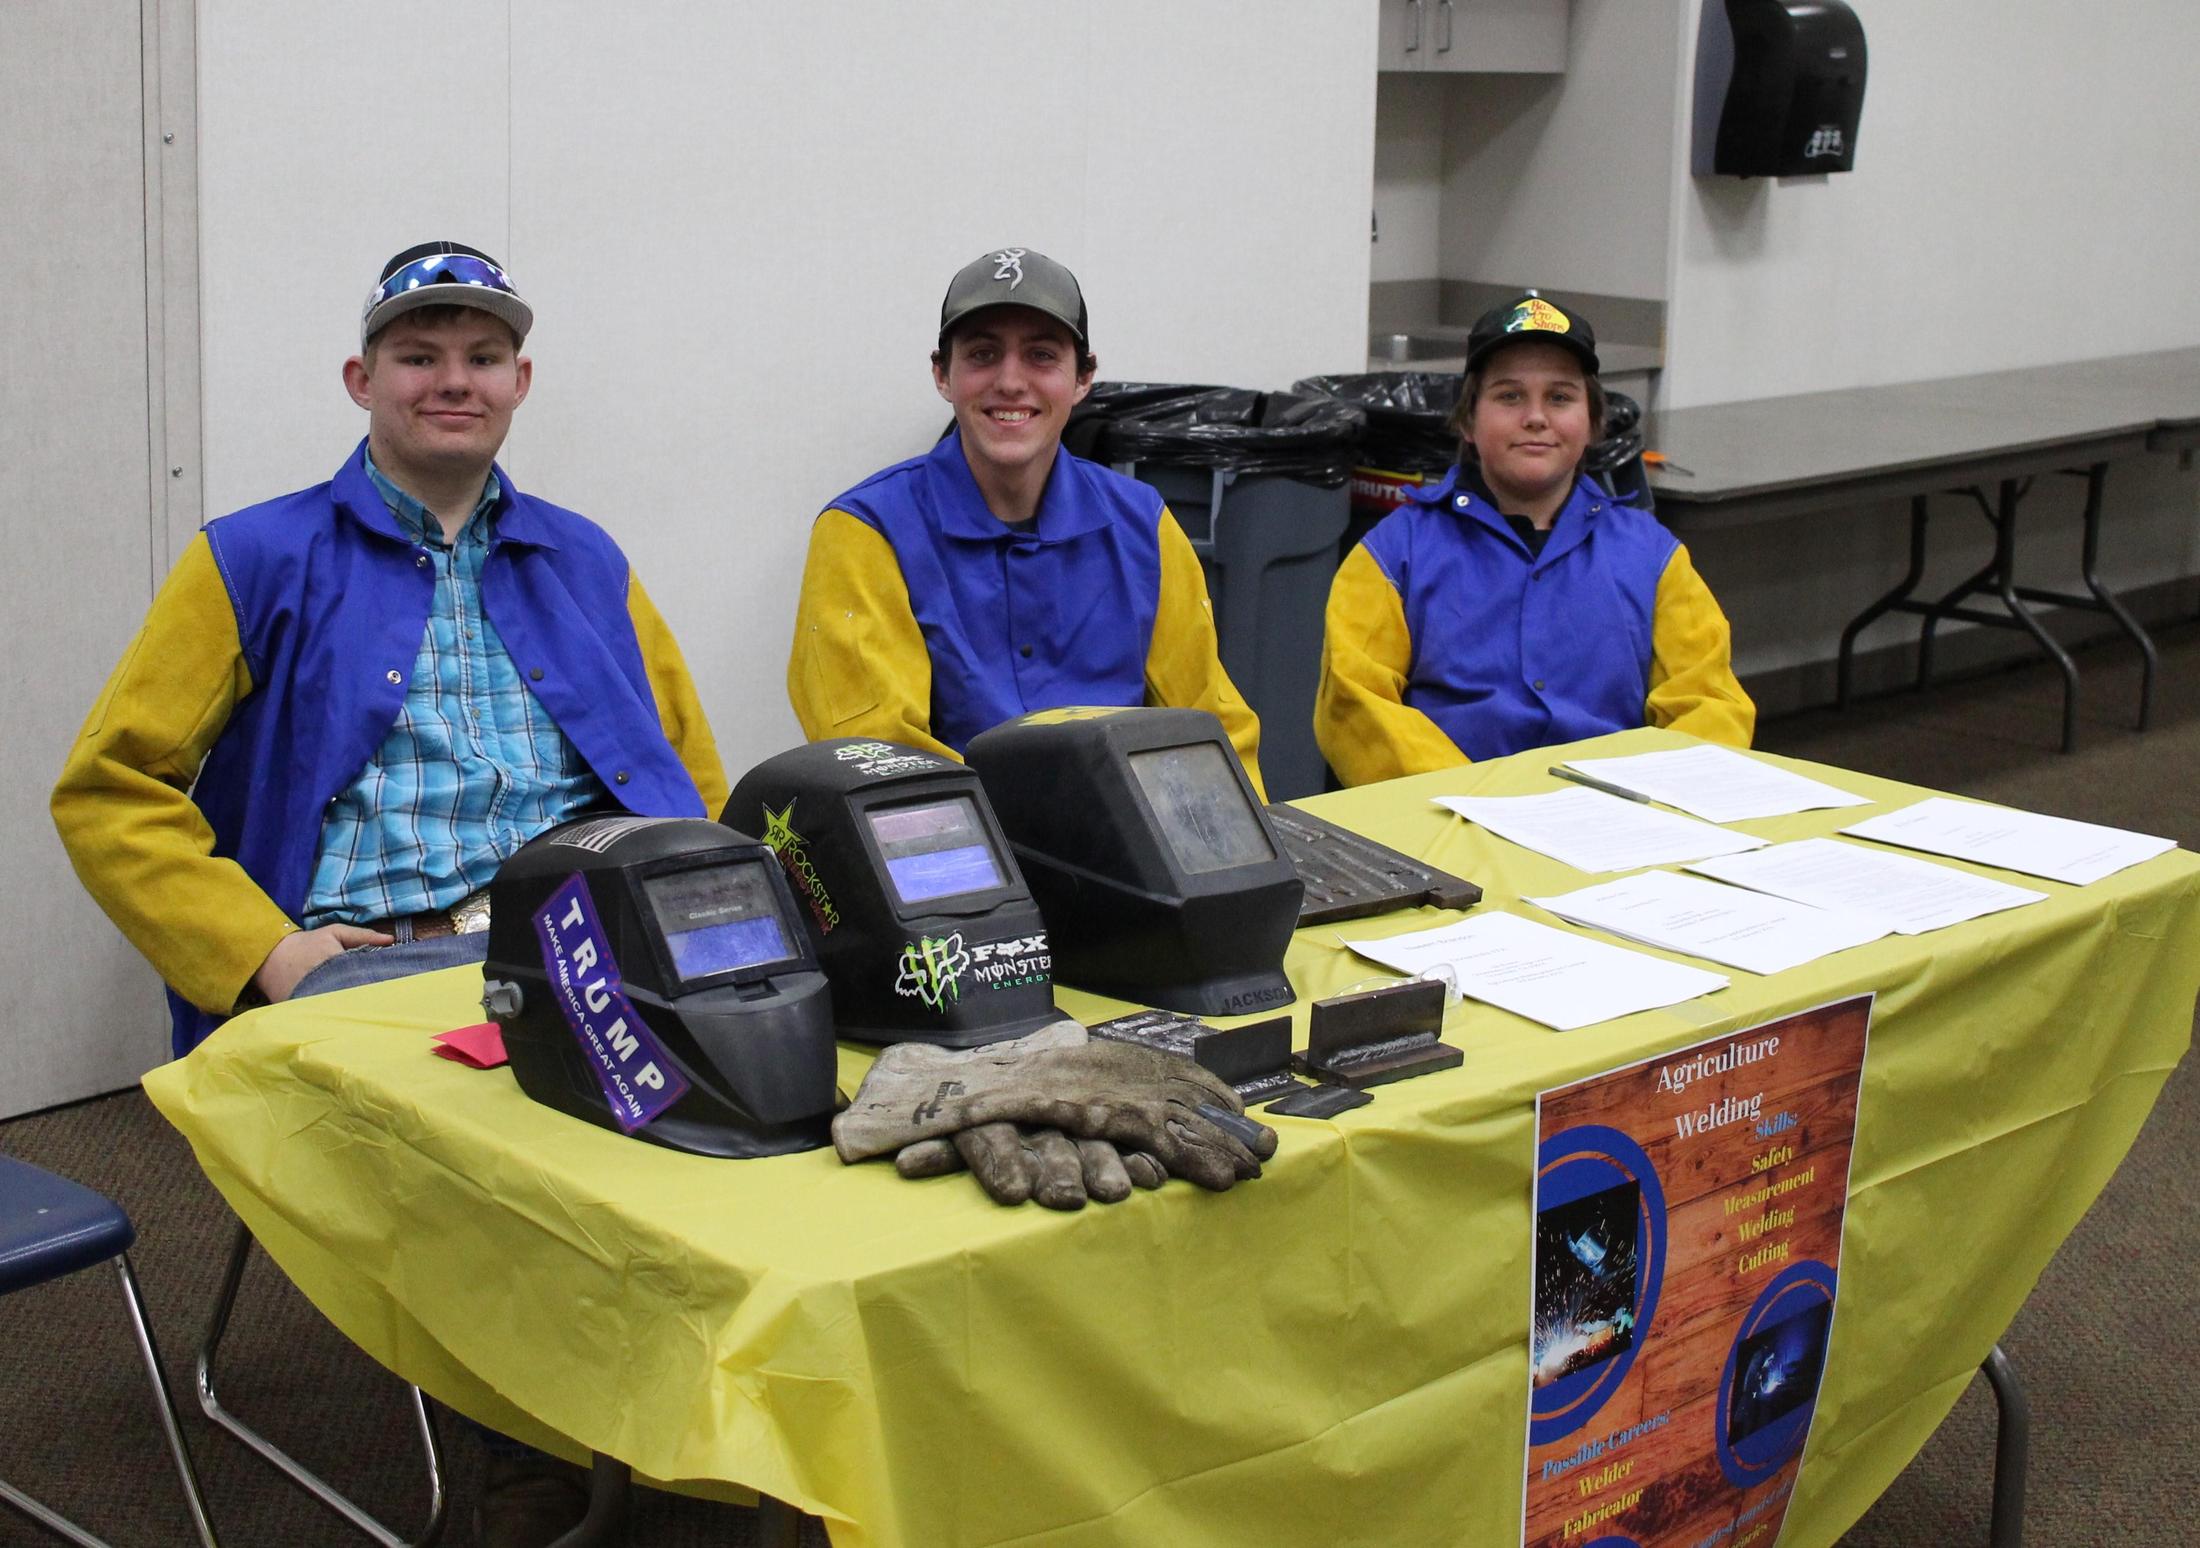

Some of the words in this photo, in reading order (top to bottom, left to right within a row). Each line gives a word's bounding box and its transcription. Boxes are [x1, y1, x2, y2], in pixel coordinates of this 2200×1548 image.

[562, 897, 665, 1090] TRUMP
[992, 974, 1050, 990] ENERGY
[544, 914, 563, 957] MAKE
[558, 959, 585, 1023] AMERICA
[585, 1024, 615, 1070] GREAT
[612, 1074, 643, 1118] AGAIN
[1656, 1036, 1780, 1094] Agriculture
[1674, 1092, 1763, 1139] Welding
[1751, 1145, 1793, 1174] Safety
[1723, 1166, 1815, 1217] Measurement
[1737, 1204, 1796, 1242] Welding
[1738, 1238, 1790, 1274] Cutting
[1542, 1438, 1605, 1480] Possible
[1579, 1460, 1634, 1497] Welder
[1564, 1488, 1643, 1540] Fabricator
